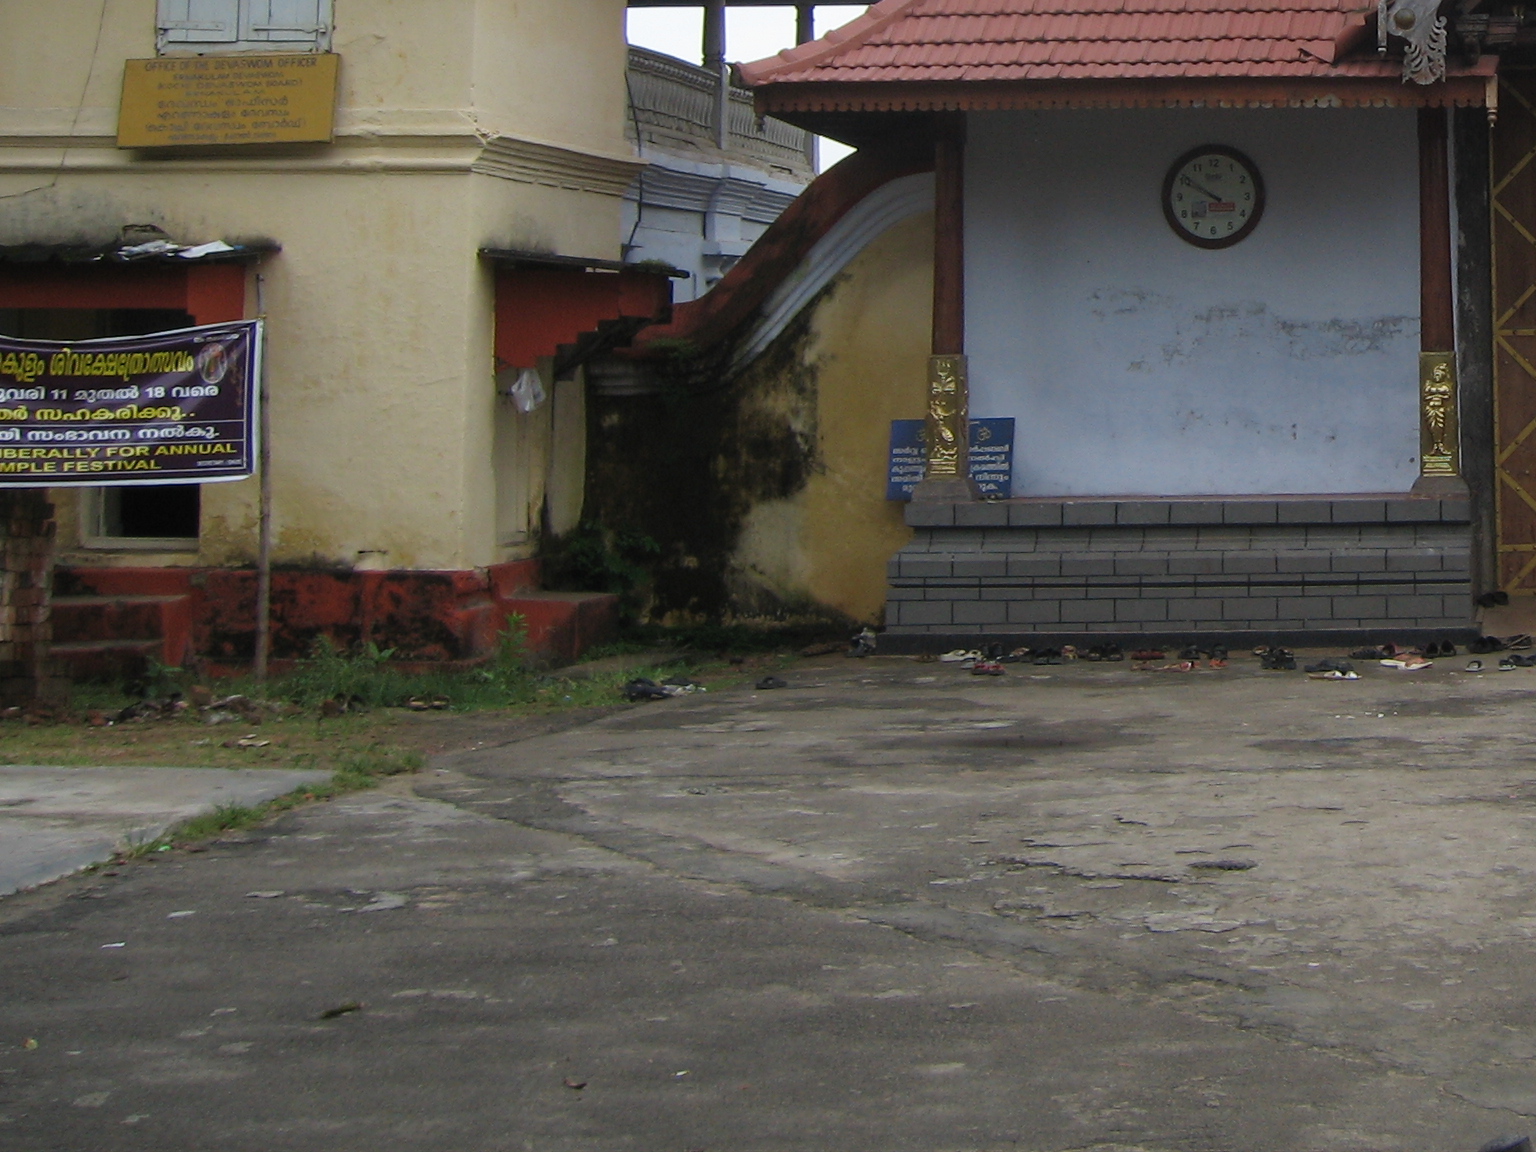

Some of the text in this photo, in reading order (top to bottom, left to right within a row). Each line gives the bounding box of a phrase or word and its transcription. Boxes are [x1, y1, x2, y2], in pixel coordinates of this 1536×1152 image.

[145, 61, 175, 71] OFFICE
[180, 60, 190, 70] OF
[195, 60, 209, 70] THE
[278, 57, 317, 68] OFFICER
[50, 389, 68, 400] 11
[145, 386, 166, 398] 18
[106, 446, 151, 458] FOR
[154, 443, 238, 456] ANNUAL
[62, 459, 162, 473] FESTIVAL
